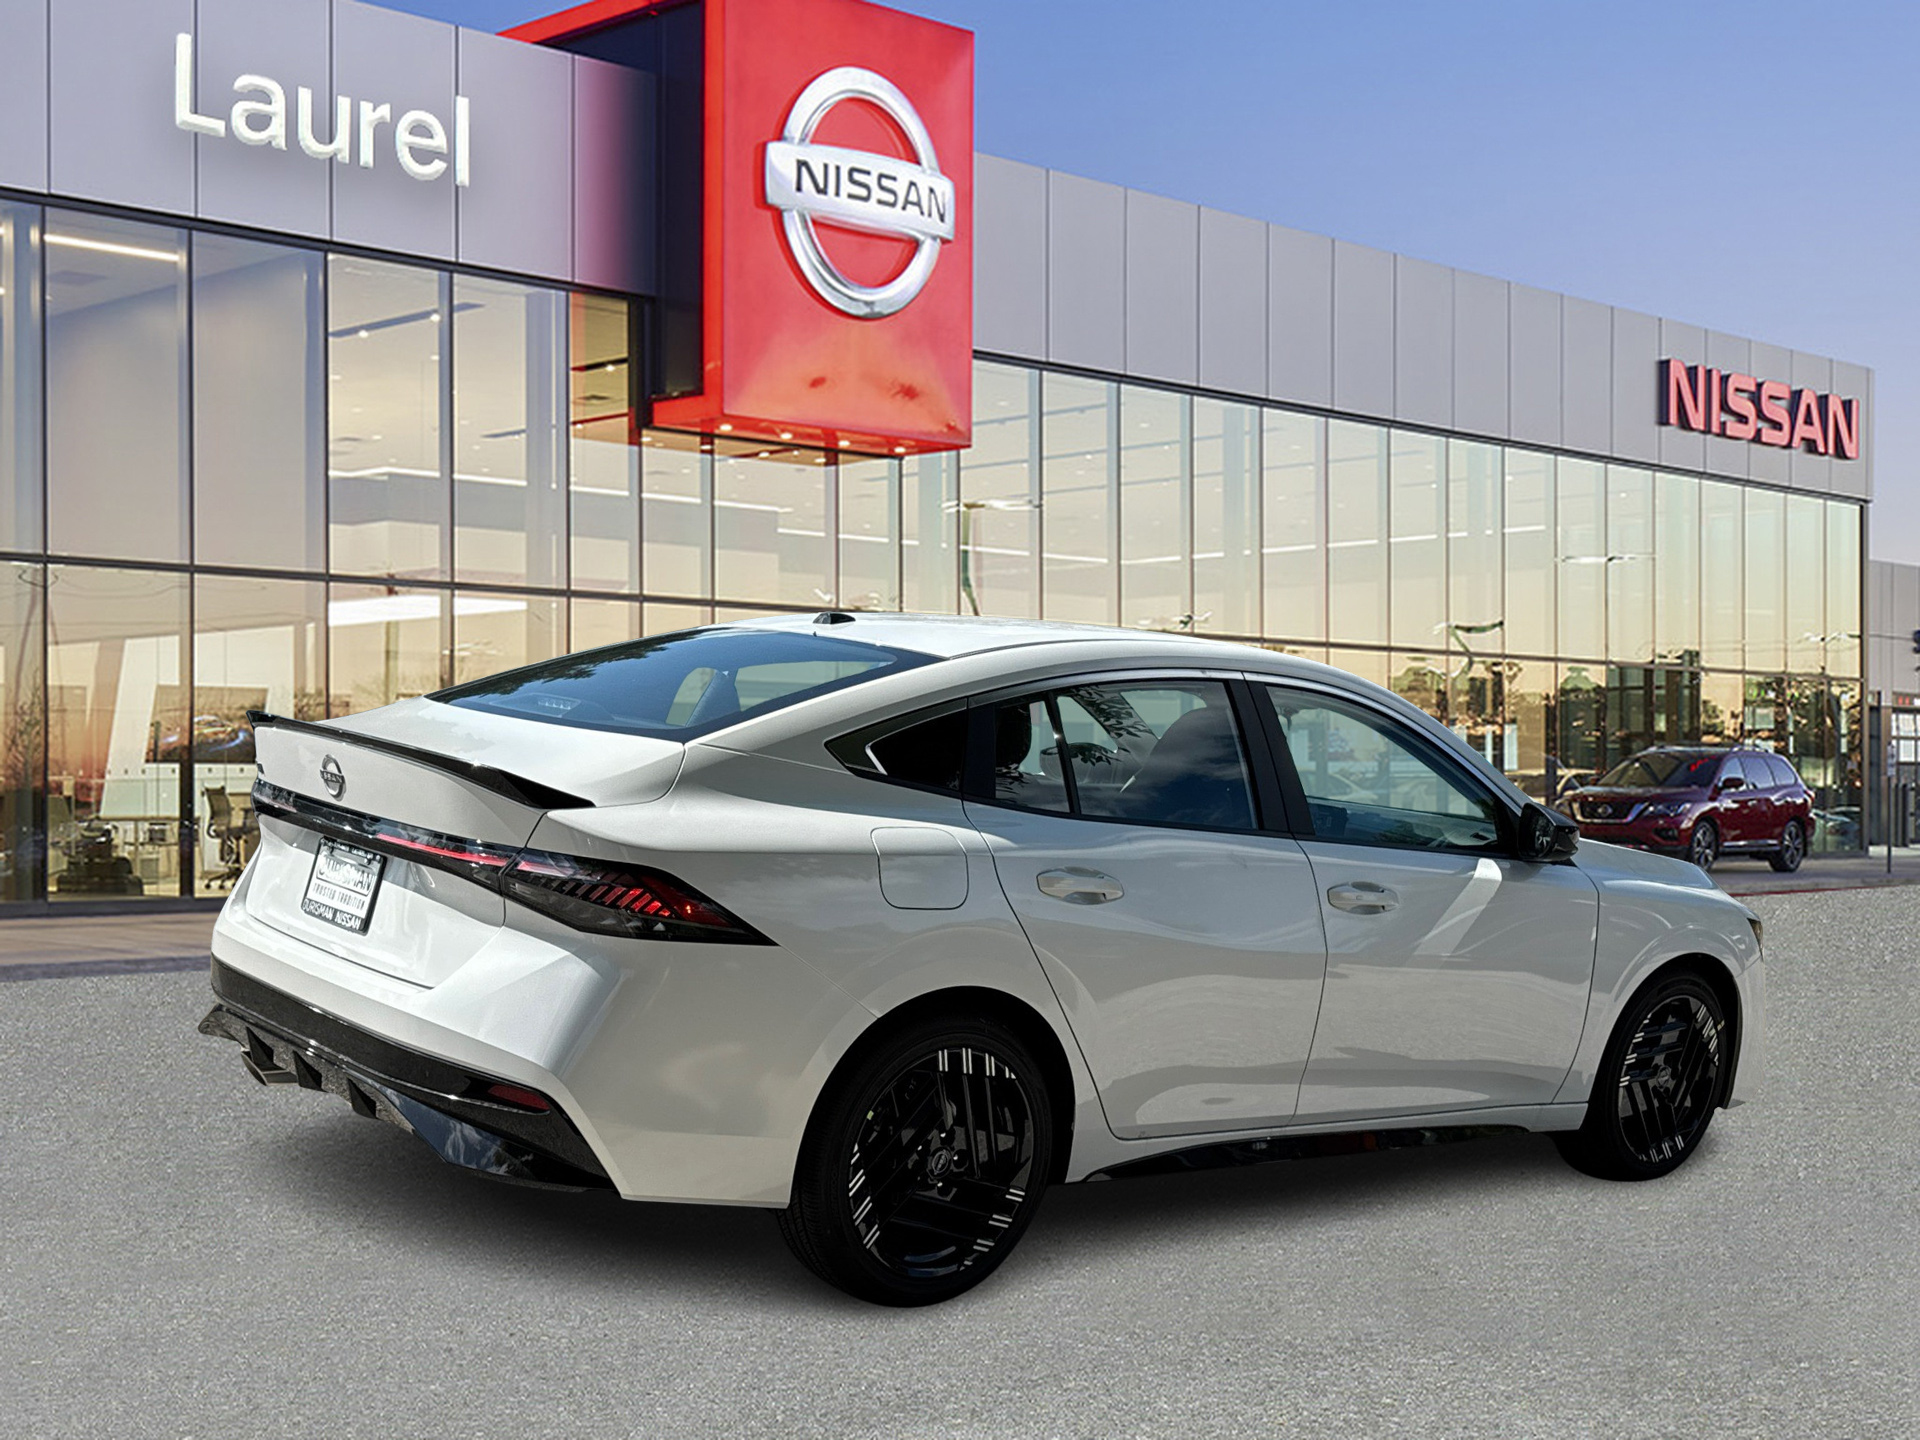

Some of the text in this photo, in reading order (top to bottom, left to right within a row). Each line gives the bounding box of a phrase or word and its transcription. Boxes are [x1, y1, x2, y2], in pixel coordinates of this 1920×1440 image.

[175, 32, 470, 188] Laurel
[795, 158, 947, 224] NISSAN
[1657, 358, 1860, 460] NISSAN
[302, 898, 362, 930] OURISMAN NISSAN
